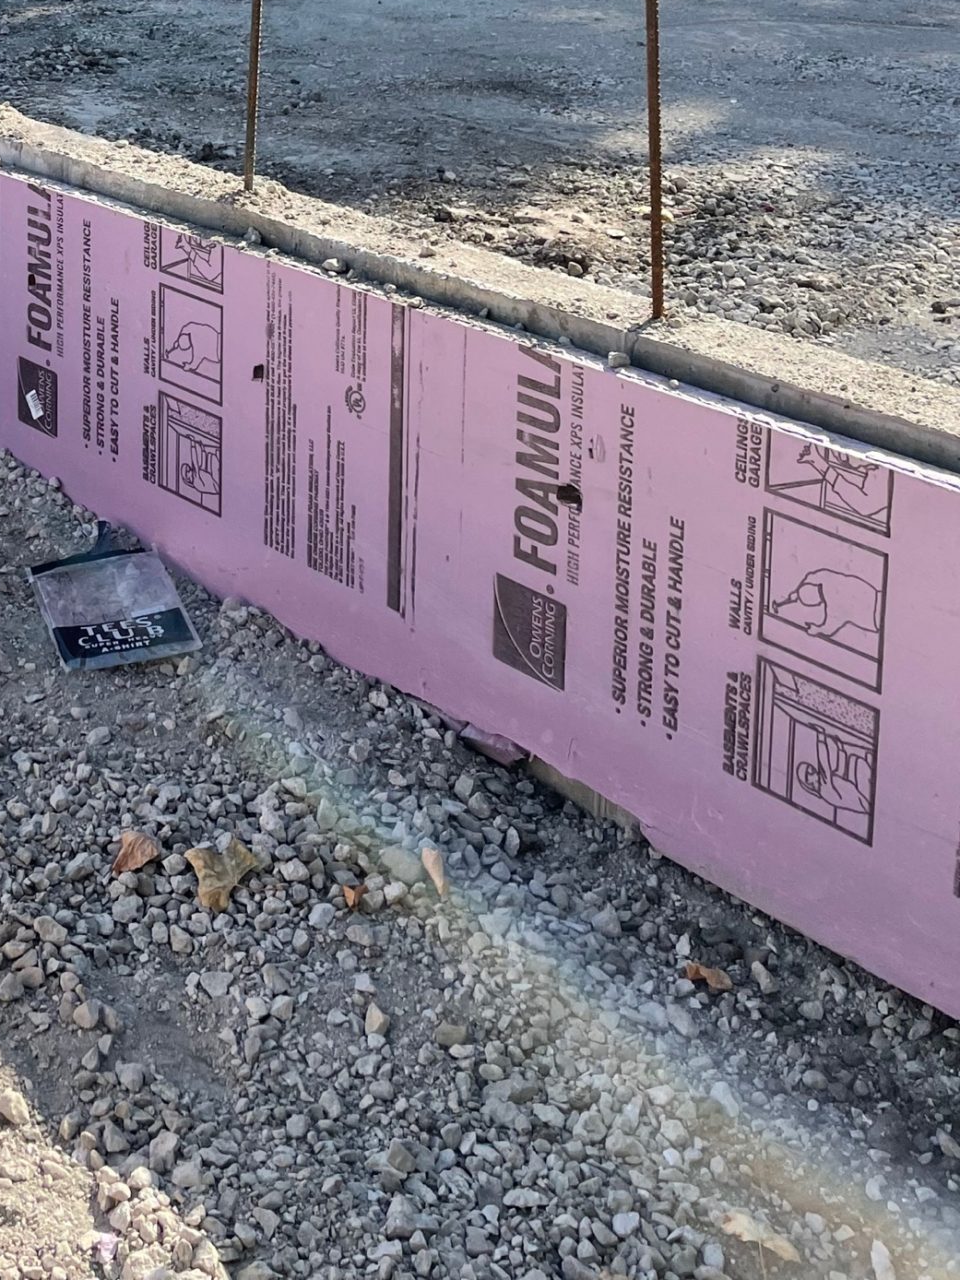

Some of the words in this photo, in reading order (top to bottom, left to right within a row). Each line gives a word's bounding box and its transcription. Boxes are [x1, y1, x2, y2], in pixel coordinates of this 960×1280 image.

[83, 218, 92, 303] RESISTANCE
[83, 304, 91, 374] MOISTURE
[97, 315, 105, 379] DURABLE
[111, 296, 120, 354] HANDLE
[97, 380, 105, 391] &
[111, 355, 119, 366] &
[111, 366, 119, 396] CUT
[38, 370, 46, 410] WENS
[44, 372, 52, 430] CORNING
[83, 375, 91, 442] SUPERIOR
[111, 398, 119, 416] TO
[97, 393, 105, 449] STRONG
[111, 418, 119, 456] EASY
[142, 414, 150, 481] BASEMENTS
[570, 422, 583, 450] XPS
[617, 403, 636, 518] RESISTANCE
[748, 420, 763, 489] GARAGE
[567, 452, 584, 549] PERFOANCE
[668, 516, 685, 594] HANDLE
[746, 515, 757, 552] SIDING
[566, 549, 580, 586] HIGH
[614, 519, 632, 615] MOISTURE
[640, 538, 657, 625] DURABLE
[744, 552, 755, 589] UNDER
[80, 616, 153, 636] TEES
[529, 594, 544, 659] OWENS
[665, 609, 682, 651] CUT
[667, 596, 683, 611] &
[728, 577, 742, 630] WALLS
[743, 598, 753, 636] CAVITY
[78, 625, 165, 647] CLUB
[541, 601, 556, 679] CORNING
[612, 617, 630, 706] SUPERIOR
[639, 626, 655, 641] &
[637, 641, 654, 719] STRONG
[664, 652, 681, 680] TO
[662, 681, 680, 732] EASY
[722, 683, 738, 776] BASEMENTS
[735, 671, 752, 782] CRAWLSPACES
